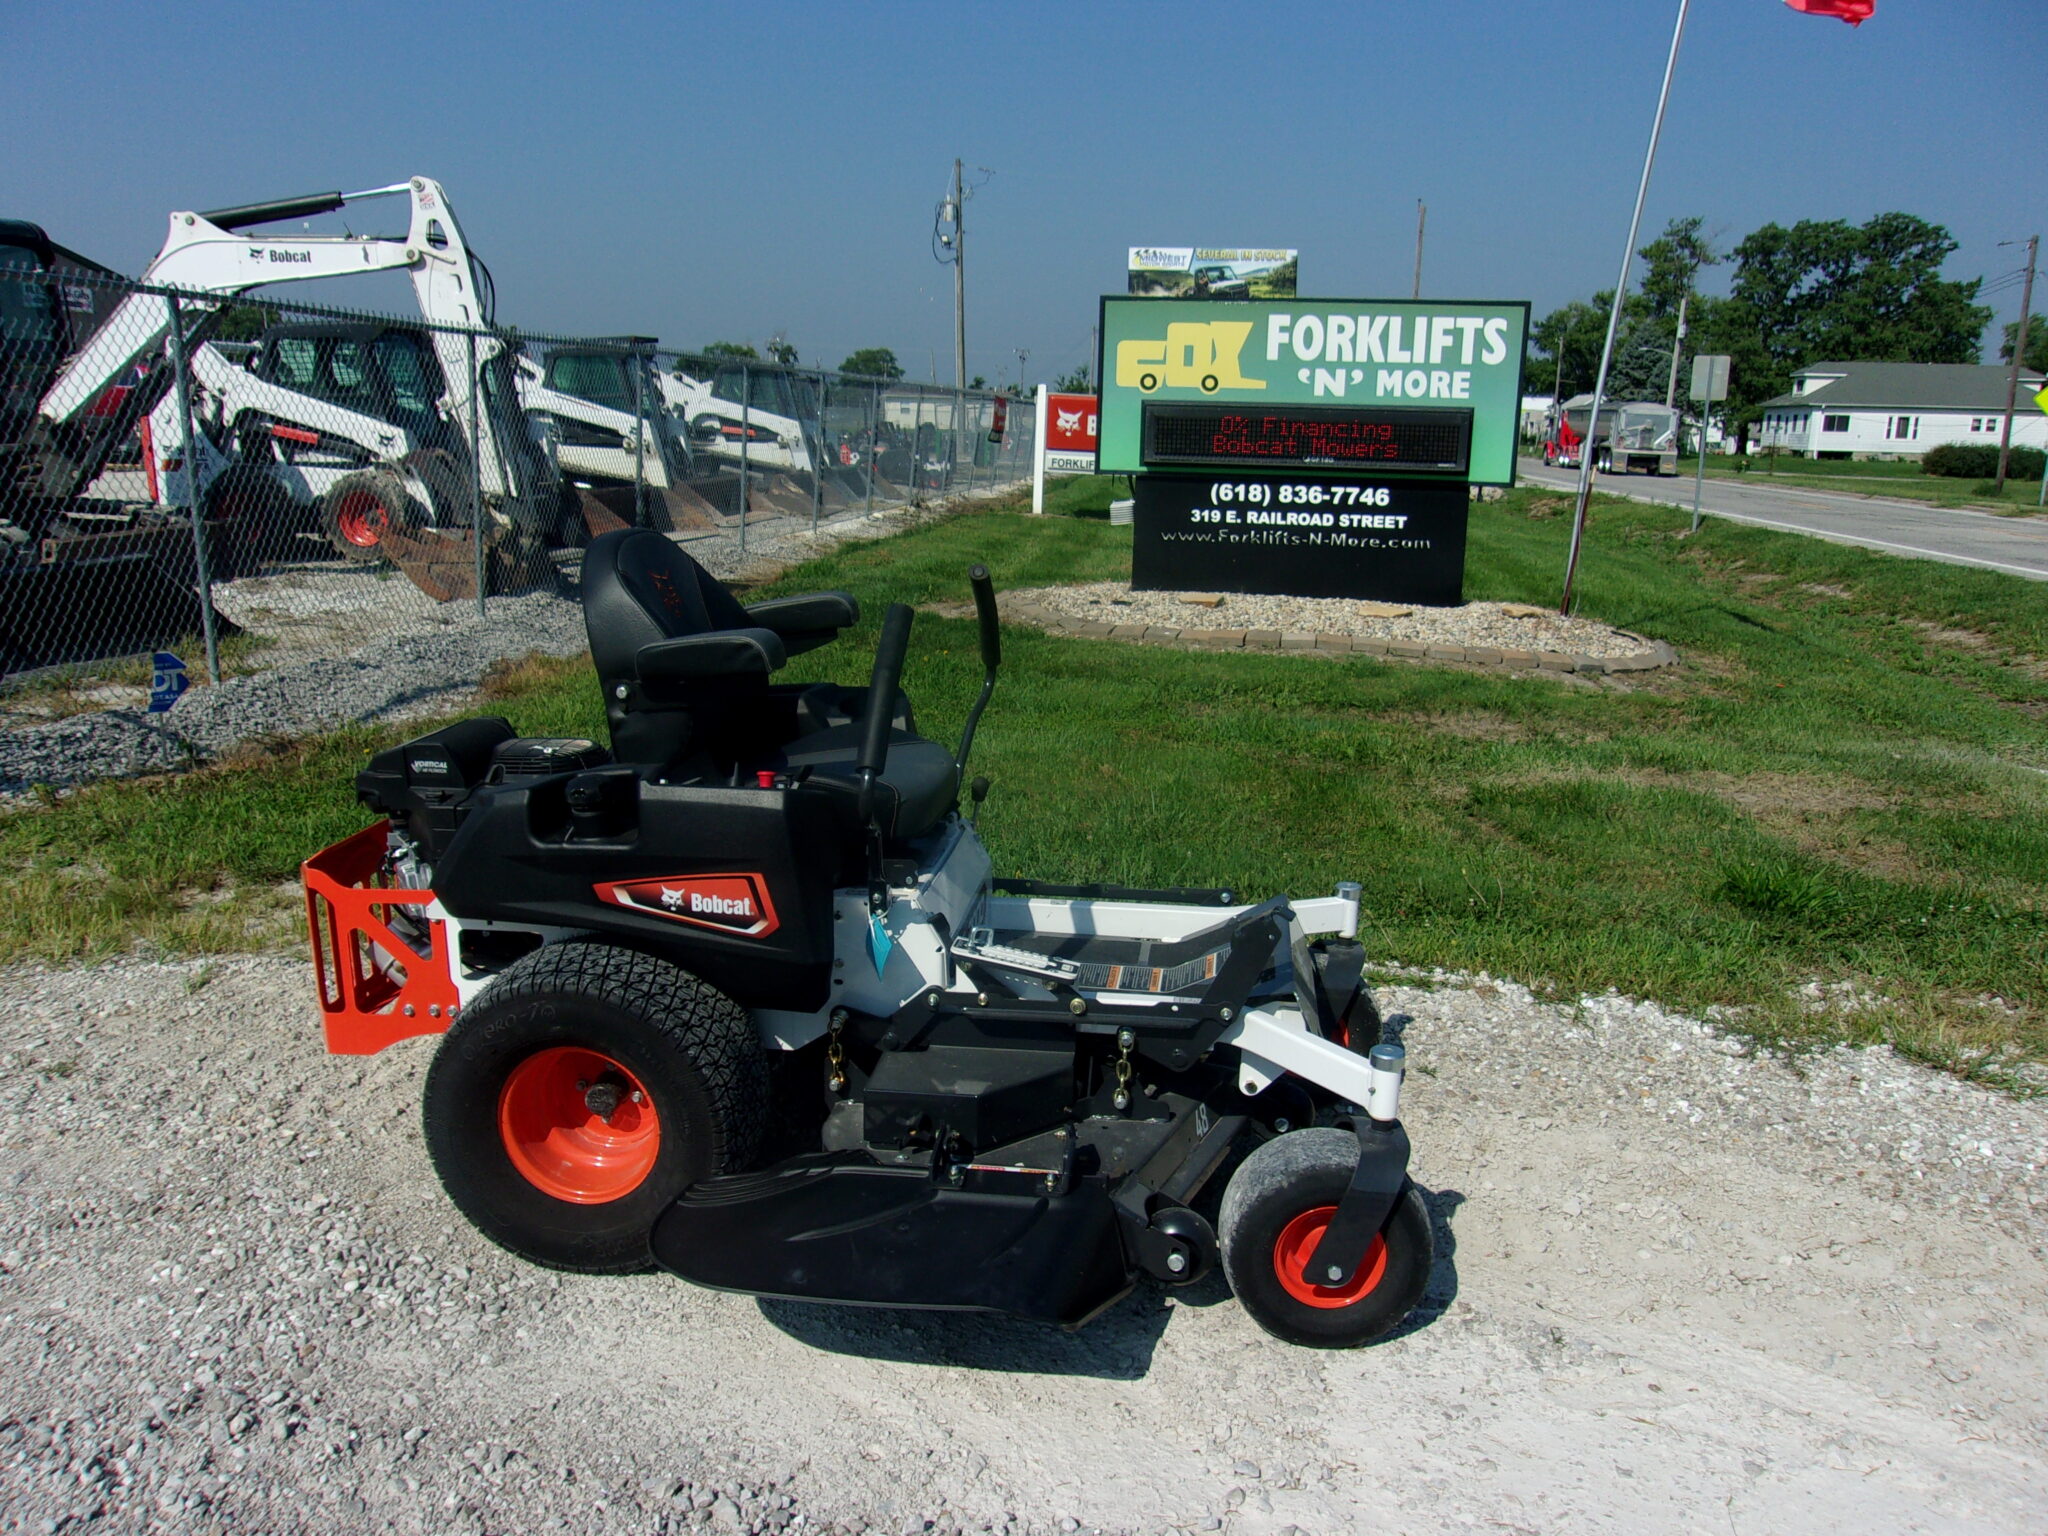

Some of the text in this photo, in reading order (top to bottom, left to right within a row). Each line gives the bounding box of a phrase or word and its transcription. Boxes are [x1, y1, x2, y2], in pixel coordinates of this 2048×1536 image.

[269, 249, 312, 263] Bobcat
[1196, 249, 1288, 261] SEVERAL IN STOCK
[1266, 314, 1508, 365] FORKLIFTS
[1376, 369, 1471, 399] MORE
[1220, 416, 1393, 441] 0% Financing
[1213, 434, 1400, 458] Bobcat Mowers
[1210, 483, 1390, 507] (618) 836-7746
[1190, 509, 1408, 529] 319 E. RAILROAD STREET
[1160, 529, 1431, 549] www.Forklifts-N-More.com
[691, 893, 752, 916] Bobcat
[1195, 1103, 1209, 1138] 48
